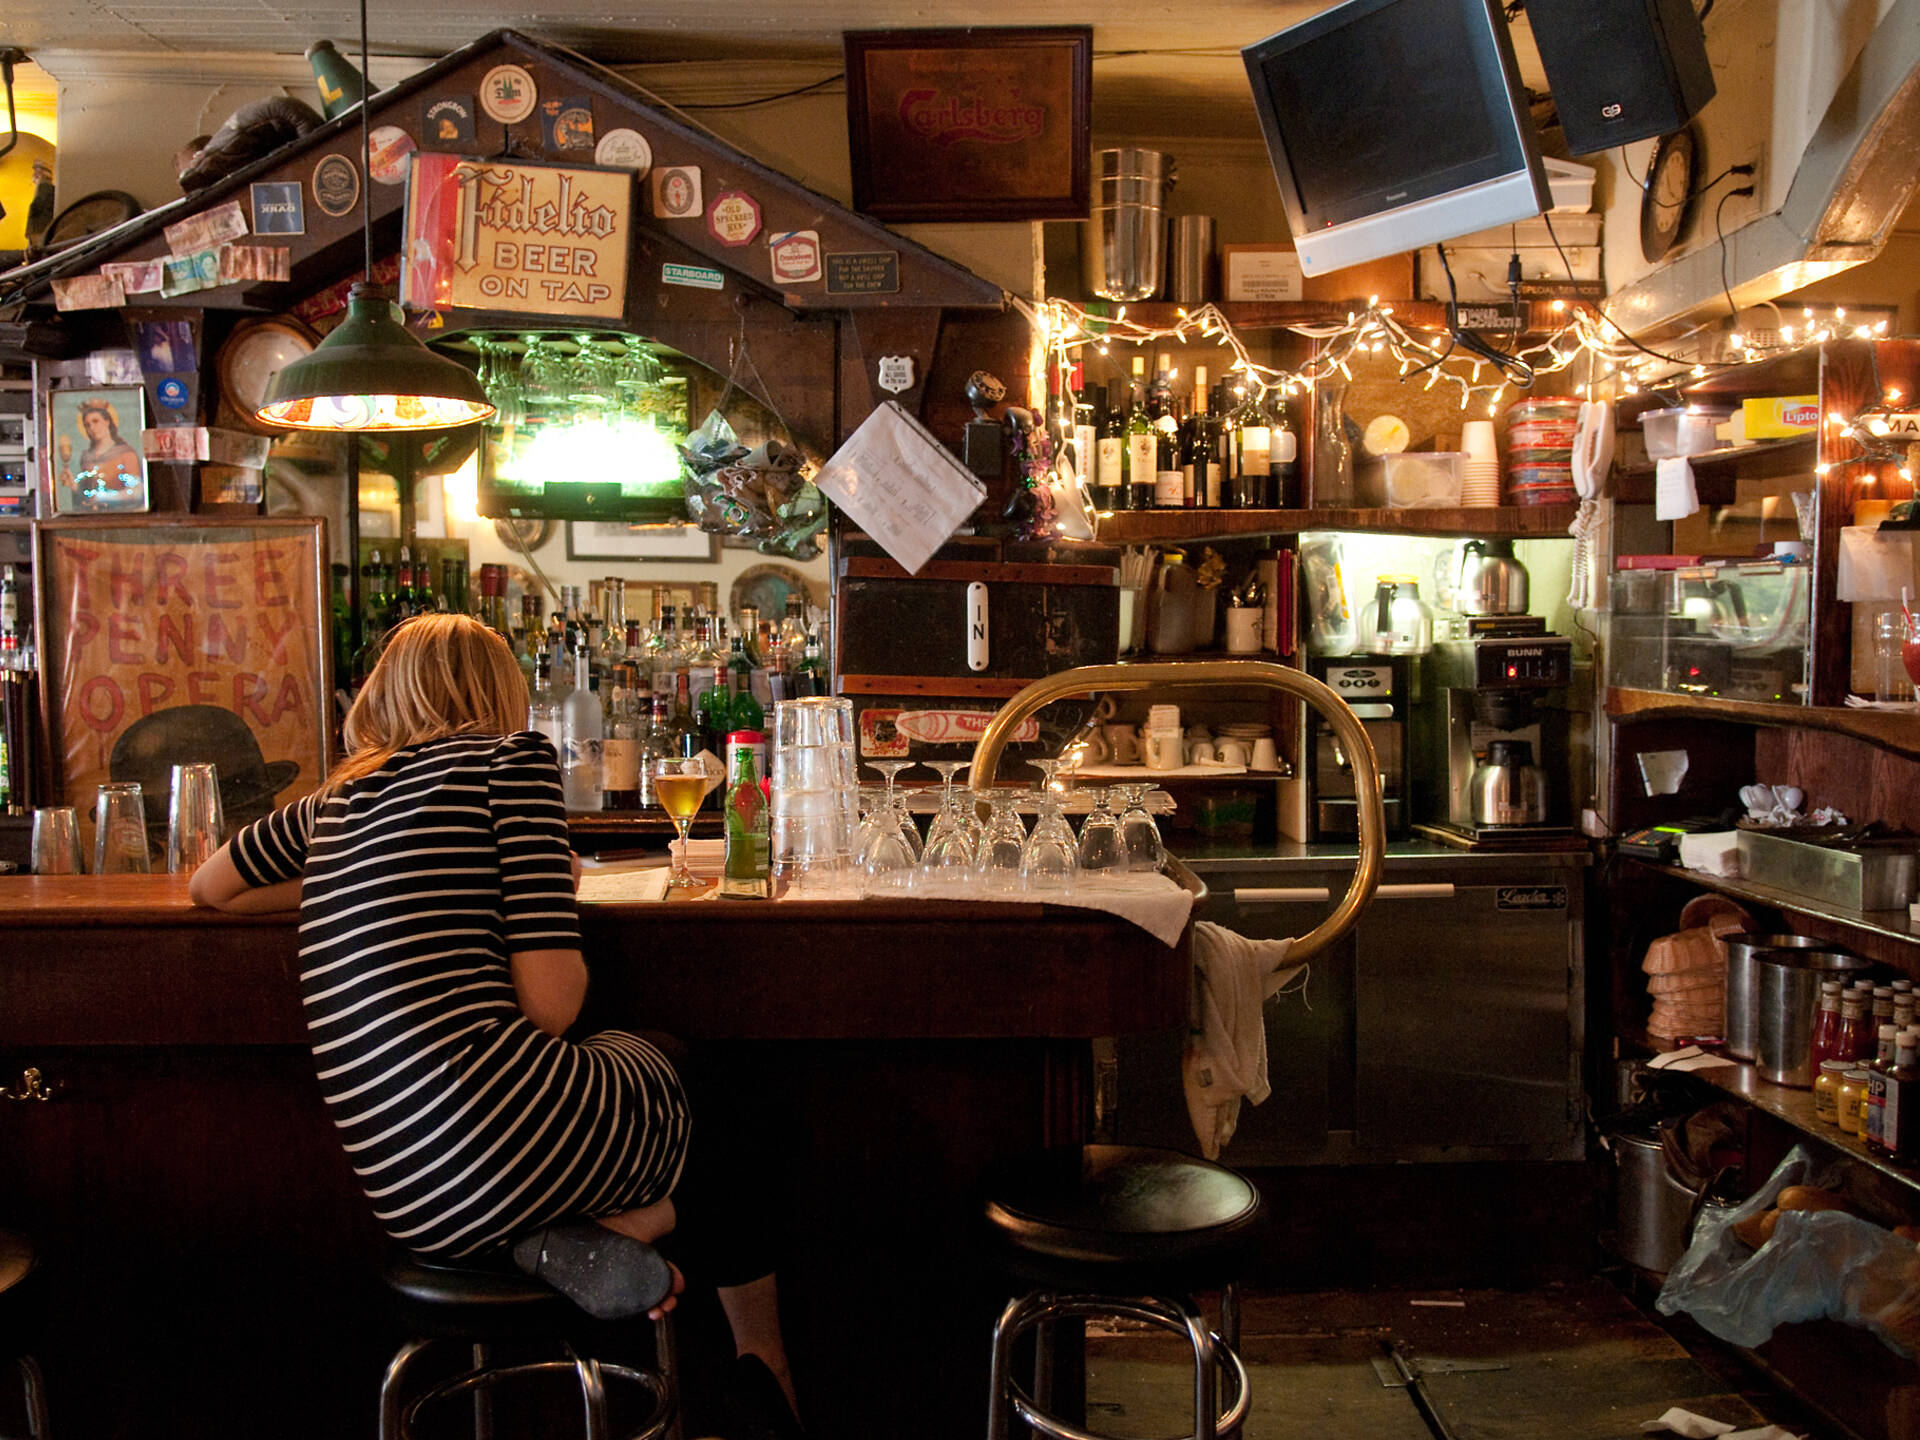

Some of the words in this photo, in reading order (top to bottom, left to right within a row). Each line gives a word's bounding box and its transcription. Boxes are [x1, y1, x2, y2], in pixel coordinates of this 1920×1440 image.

[427, 101, 467, 119] STRONGBOW
[900, 89, 1045, 137] Carlsberg
[451, 166, 616, 273] Fidelio
[494, 241, 597, 277] BEER
[665, 267, 721, 280] STARBOARD
[479, 275, 528, 298] ON
[541, 281, 611, 304] TAP
[1785, 411, 1818, 424] Lipto
[64, 547, 291, 609] THREE
[70, 611, 298, 666] PENNY
[973, 604, 985, 640] IN
[1507, 648, 1543, 657] BUNN
